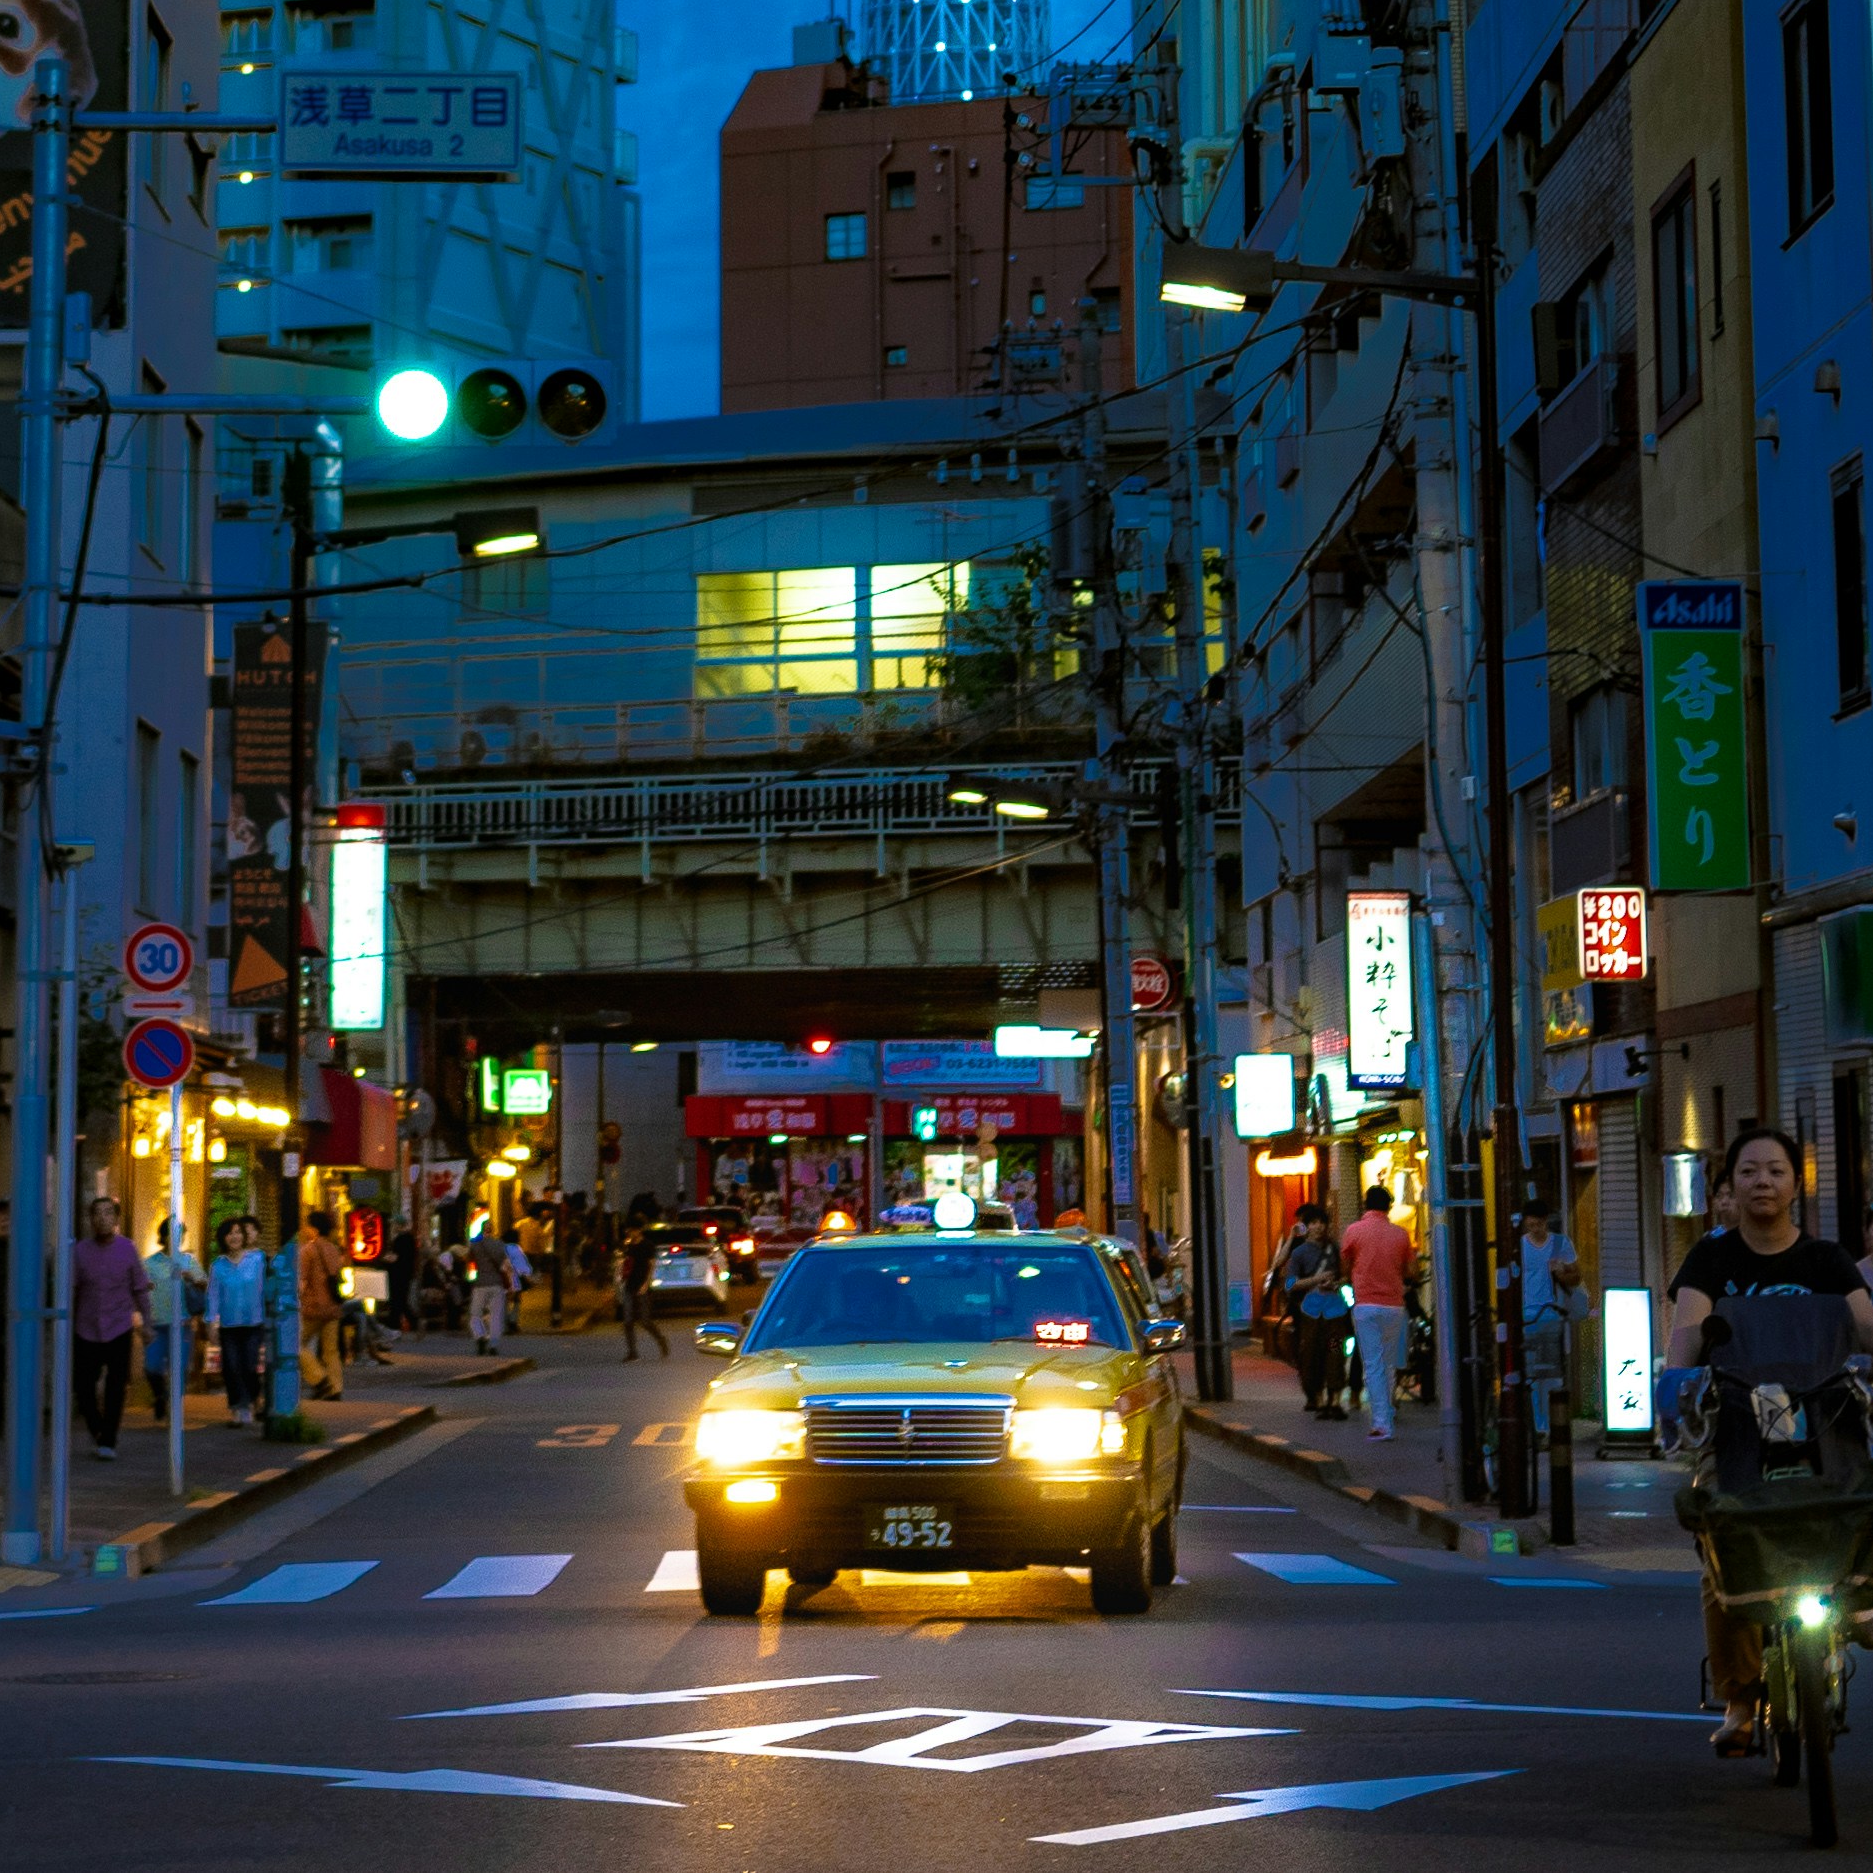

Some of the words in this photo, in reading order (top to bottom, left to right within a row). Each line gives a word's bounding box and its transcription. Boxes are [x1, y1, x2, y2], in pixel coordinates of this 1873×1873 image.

[291, 86, 507, 127] 浅草二丁目
[332, 133, 433, 156] Asakusa
[448, 134, 464, 156] 2
[1652, 591, 1734, 625] Asahi
[1662, 651, 1734, 866] 香とり
[1583, 894, 1641, 920] ¥200
[1584, 919, 1627, 947] コイン
[139, 942, 178, 975] 30
[1586, 946, 1642, 975] ロッカー
[1036, 1322, 1088, 1340] 空車
[883, 1521, 953, 1547] 49-52
